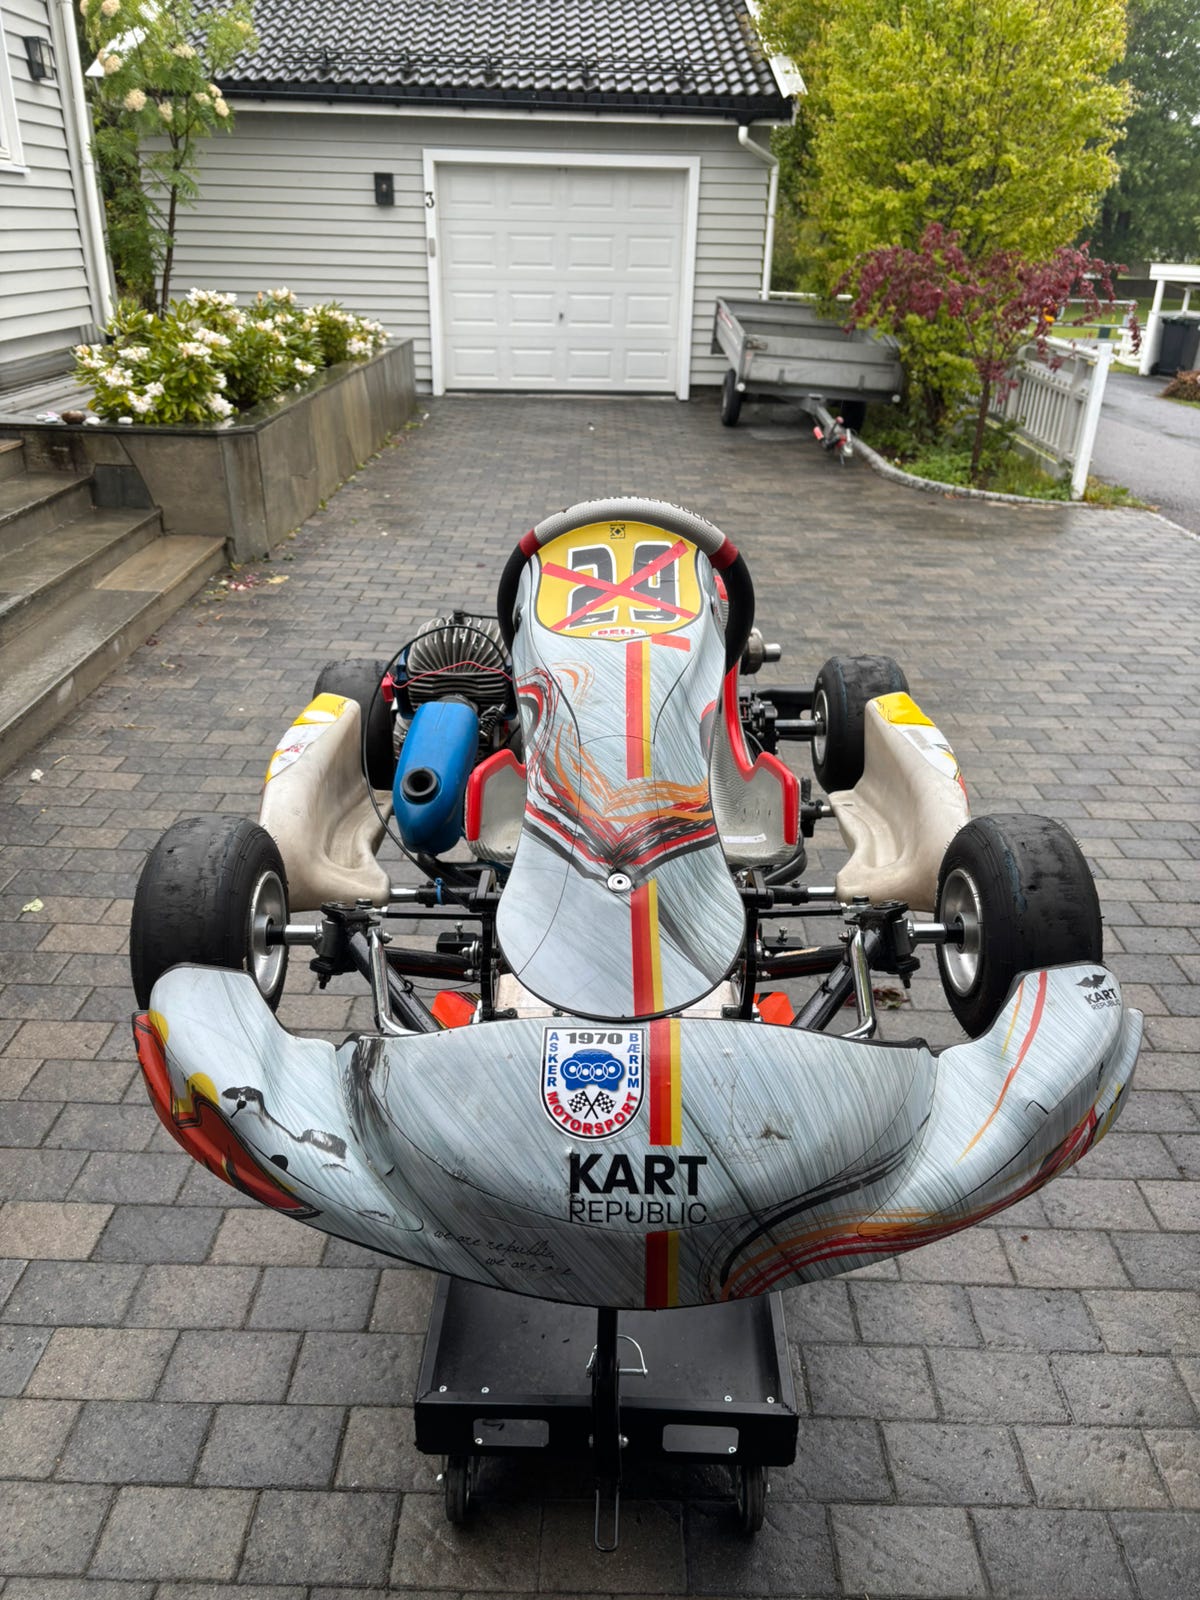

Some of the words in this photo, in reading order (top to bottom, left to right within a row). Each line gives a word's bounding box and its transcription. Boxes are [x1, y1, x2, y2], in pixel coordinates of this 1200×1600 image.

[426, 191, 434, 208] 3
[565, 541, 680, 631] 29
[1084, 988, 1118, 1004] KART
[547, 1032, 559, 1087] ASKER
[566, 1032, 623, 1045] 1970
[627, 1033, 640, 1088] BÆRUM
[547, 1091, 638, 1135] MOTORSPORT
[569, 1153, 708, 1196] KART
[569, 1200, 708, 1224] REPUBLIC
